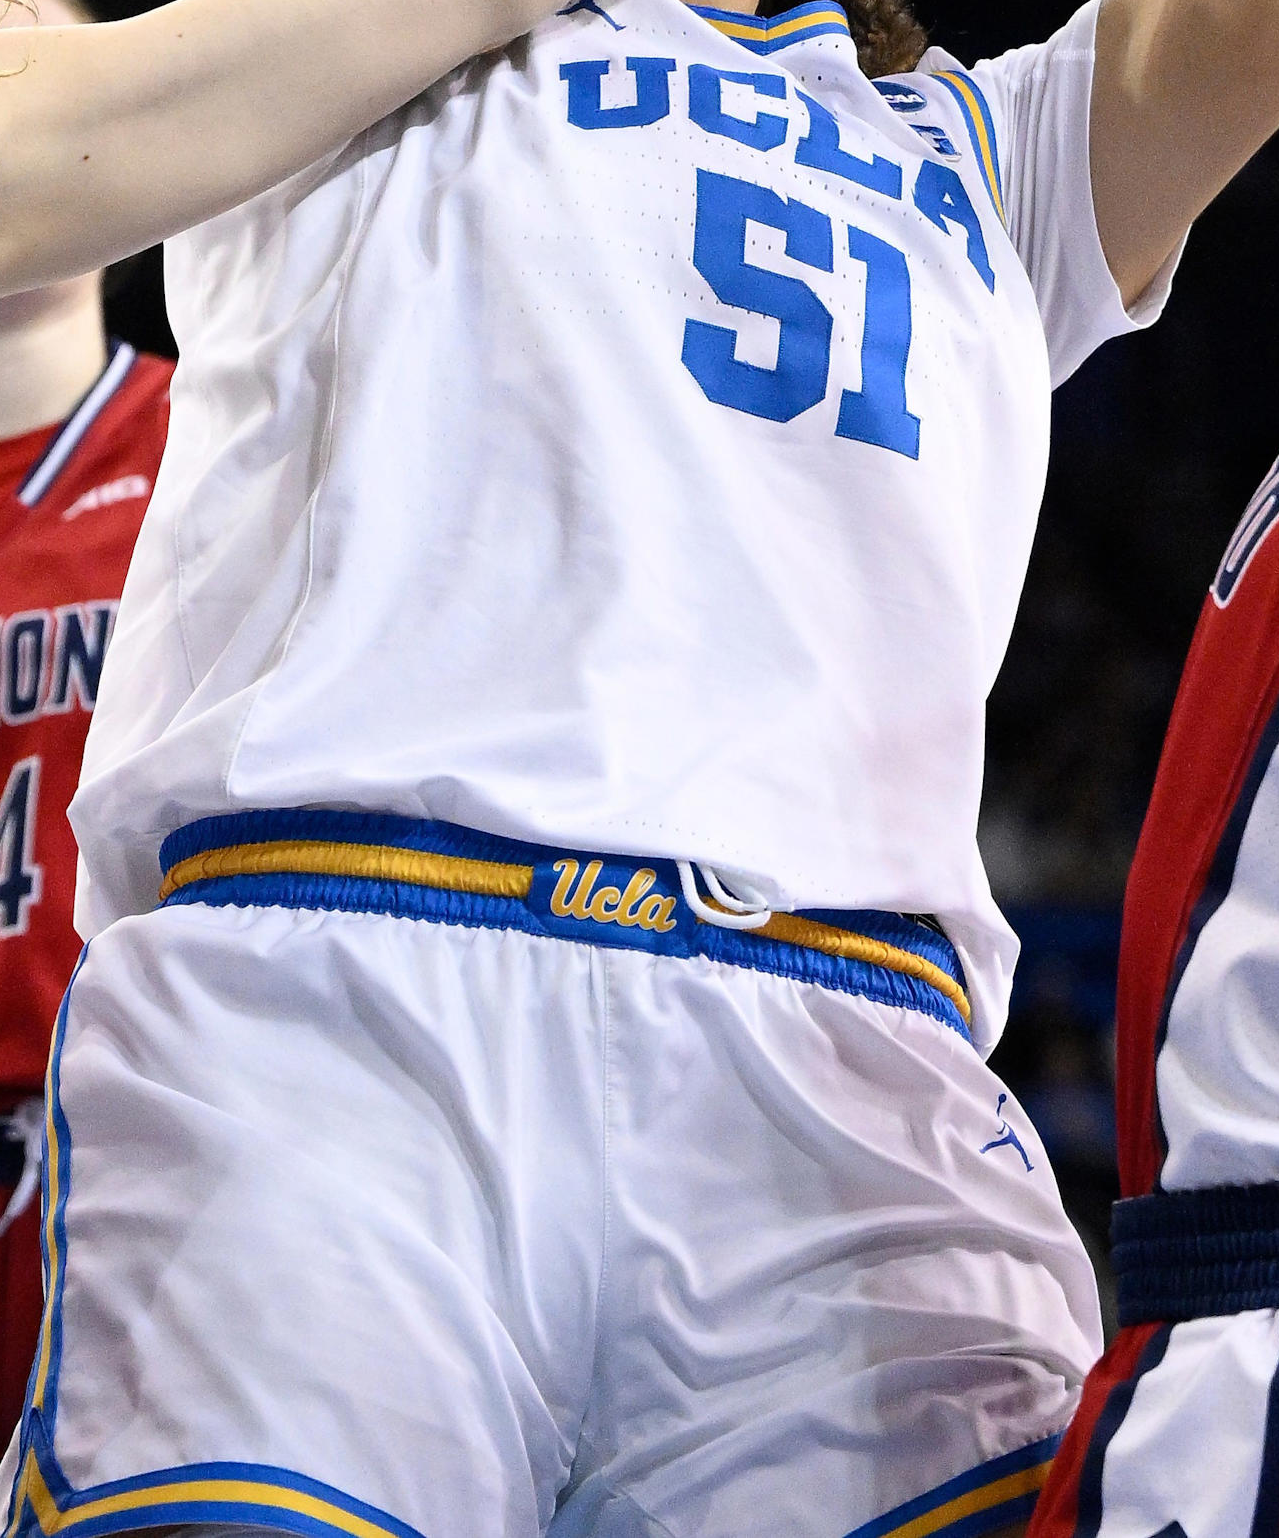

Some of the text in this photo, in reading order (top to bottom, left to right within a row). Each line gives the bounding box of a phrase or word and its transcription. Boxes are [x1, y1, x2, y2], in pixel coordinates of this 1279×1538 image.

[559, 57, 995, 295] UCLA
[681, 167, 922, 460] 51
[550, 858, 677, 933] Ucla
